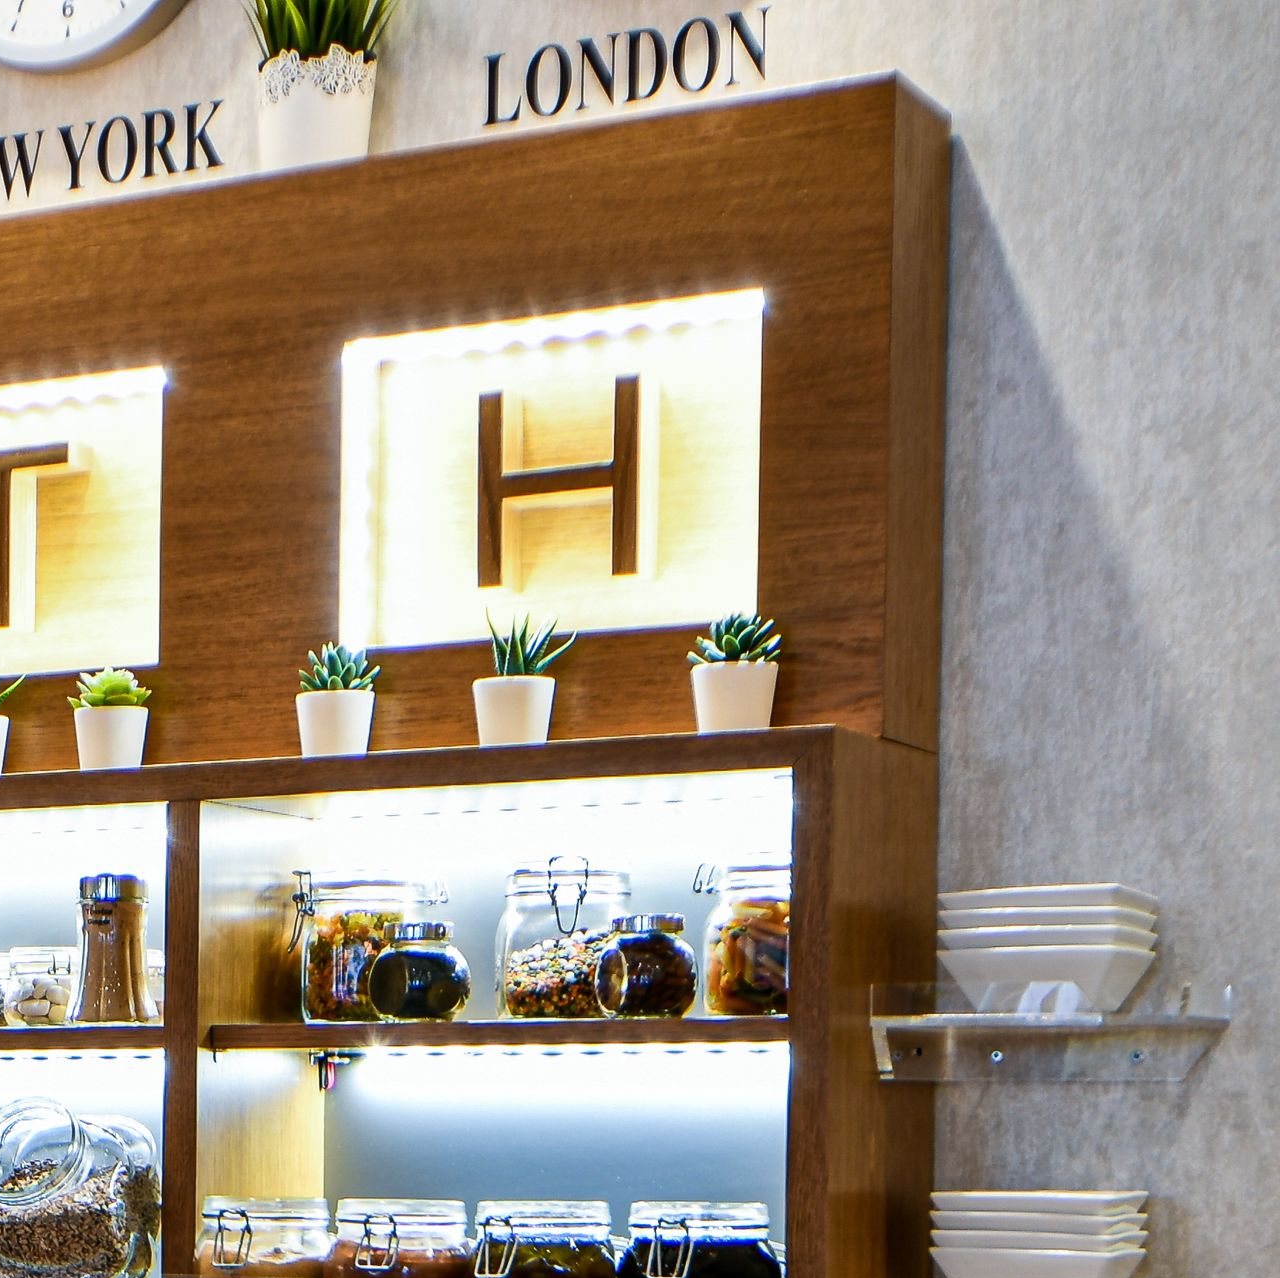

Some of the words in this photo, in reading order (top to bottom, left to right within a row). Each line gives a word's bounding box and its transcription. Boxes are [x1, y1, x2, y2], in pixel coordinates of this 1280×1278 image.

[483, 6, 771, 126] LONDON
[57, 99, 225, 191] YORK
[477, 373, 640, 588] H
